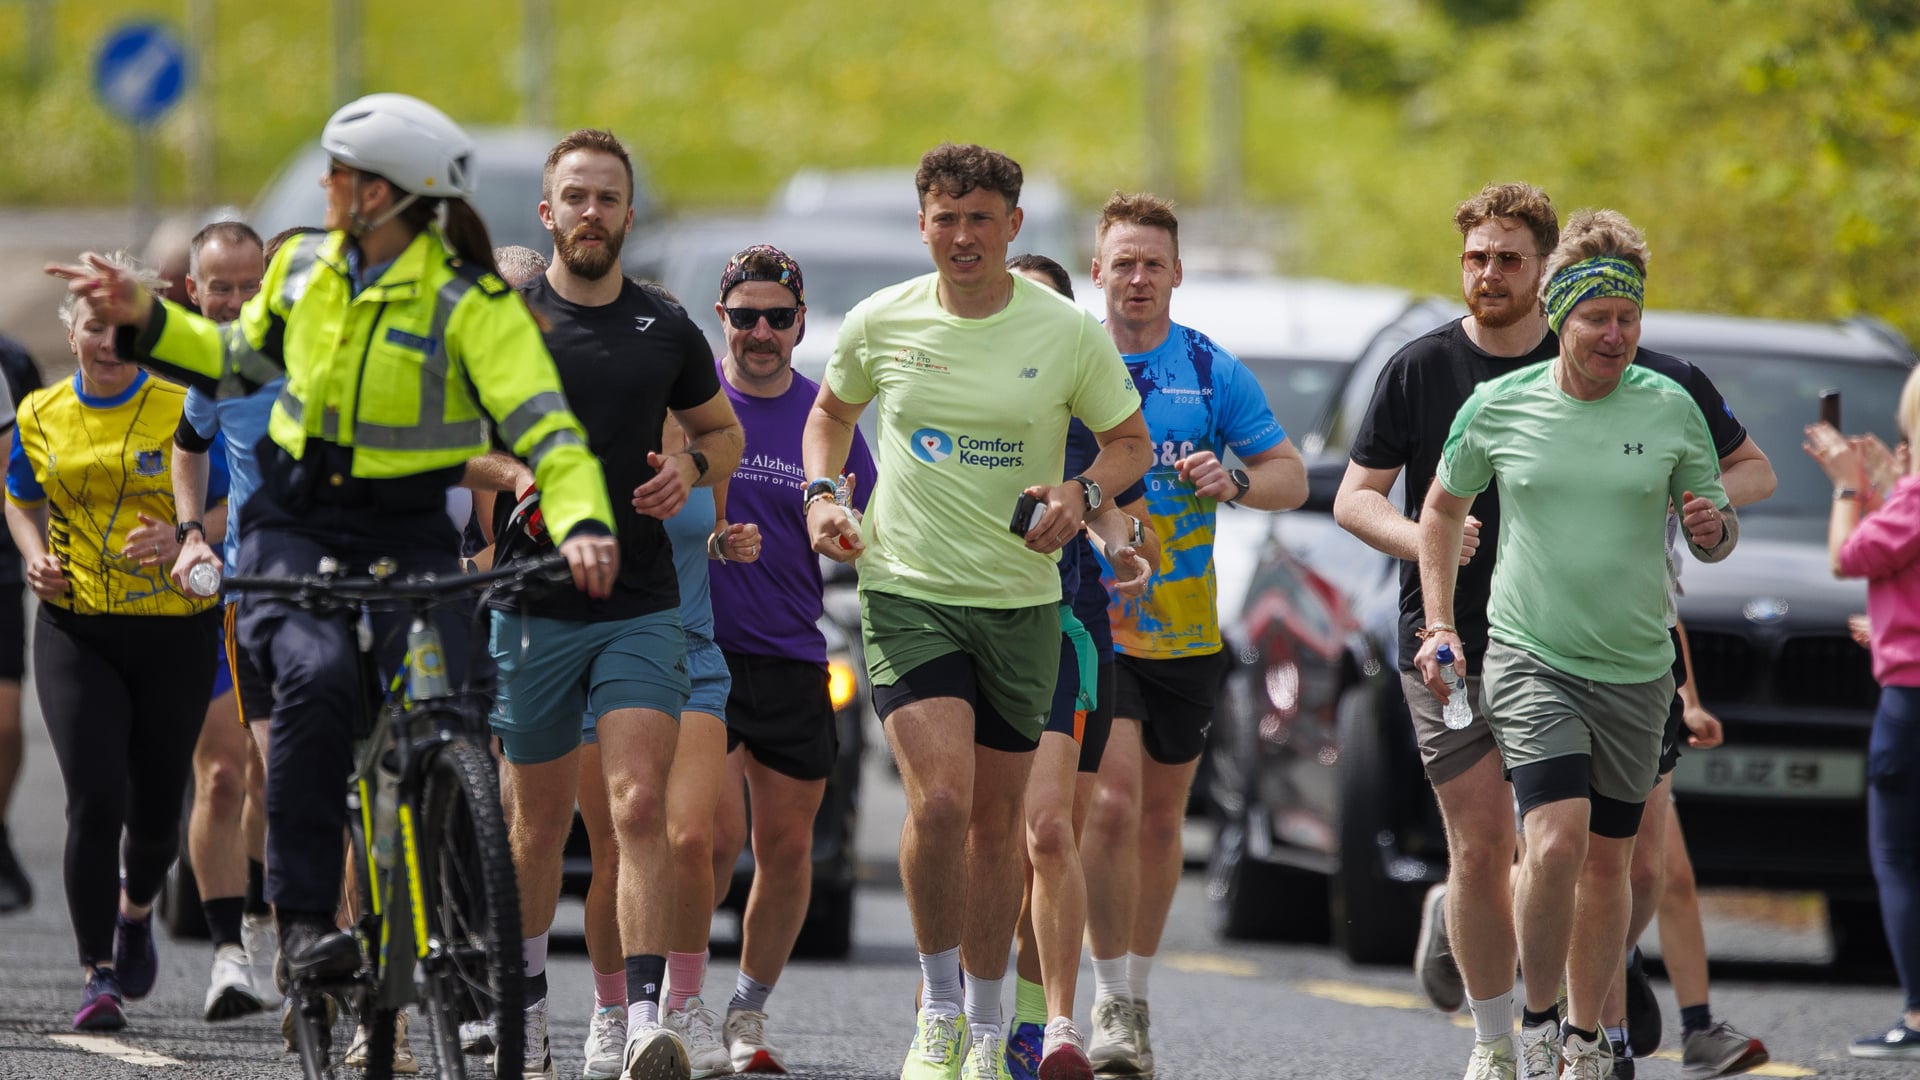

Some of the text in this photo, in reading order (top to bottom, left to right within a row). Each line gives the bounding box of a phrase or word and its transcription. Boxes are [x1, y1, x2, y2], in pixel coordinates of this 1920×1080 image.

[1174, 396, 1200, 404] 2025
[957, 434, 1025, 453] Comfort
[751, 454, 805, 478] Alzheim
[732, 471, 801, 490] SOCIETY OF IRE
